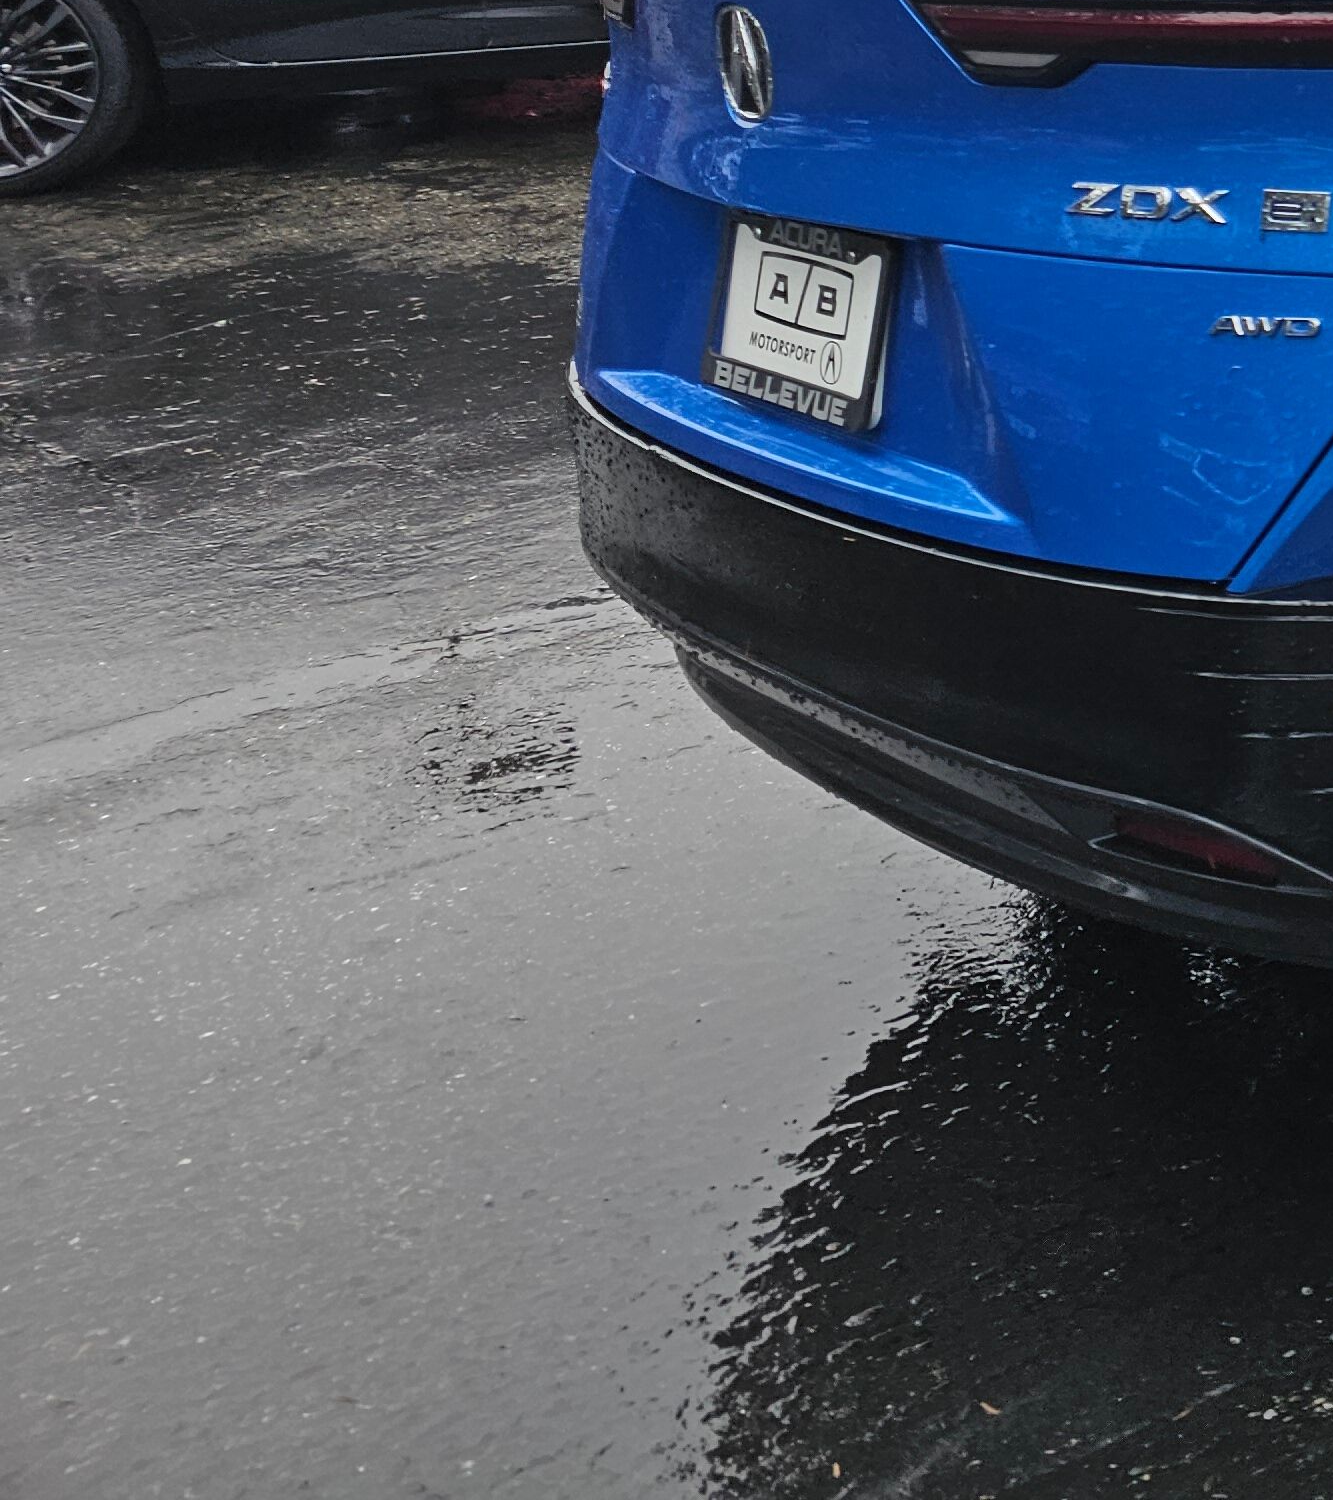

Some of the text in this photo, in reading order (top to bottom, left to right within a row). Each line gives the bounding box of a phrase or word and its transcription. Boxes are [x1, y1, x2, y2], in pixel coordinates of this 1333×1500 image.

[1065, 181, 1231, 224] ZDX
[768, 219, 843, 259] ACURA
[1209, 314, 1322, 338] AWD
[749, 331, 816, 365] MOTORSPORT
[713, 360, 849, 427] BELLEVUE
